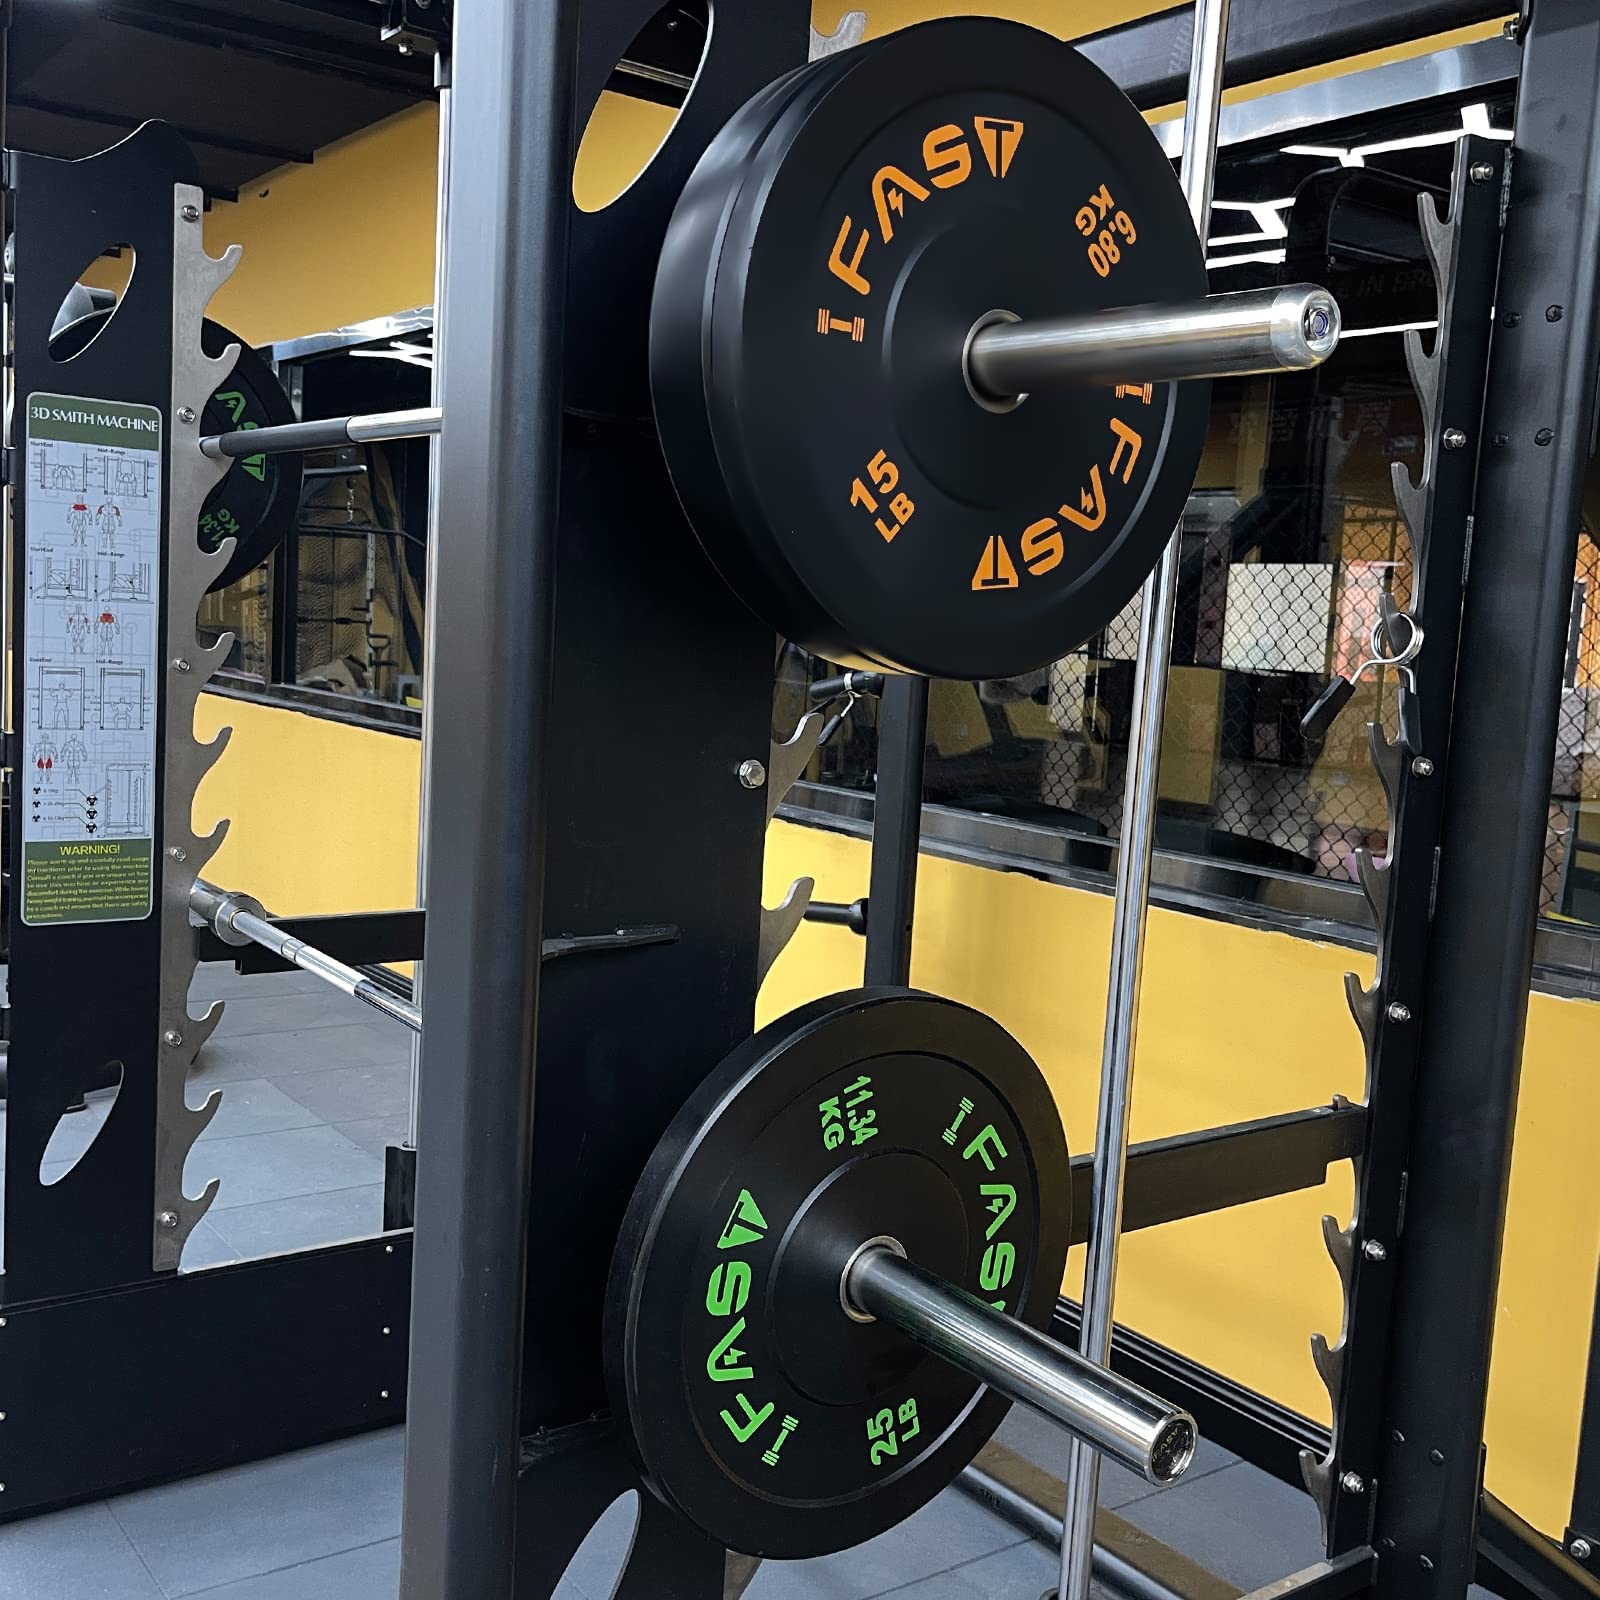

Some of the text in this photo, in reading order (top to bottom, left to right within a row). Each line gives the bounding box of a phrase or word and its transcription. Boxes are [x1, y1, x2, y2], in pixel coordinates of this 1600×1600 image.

[1075, 184, 1115, 236] KG
[1087, 210, 1136, 277] 6.80
[31, 407, 158, 432] 3D SMITH MACHINE
[850, 449, 899, 514] 15
[874, 492, 916, 542] LB
[60, 845, 120, 855] WARNING!
[818, 1096, 844, 1151] KG
[843, 1075, 879, 1147] 11.34
[867, 1408, 899, 1465] 25
[897, 1397, 920, 1442] LB
